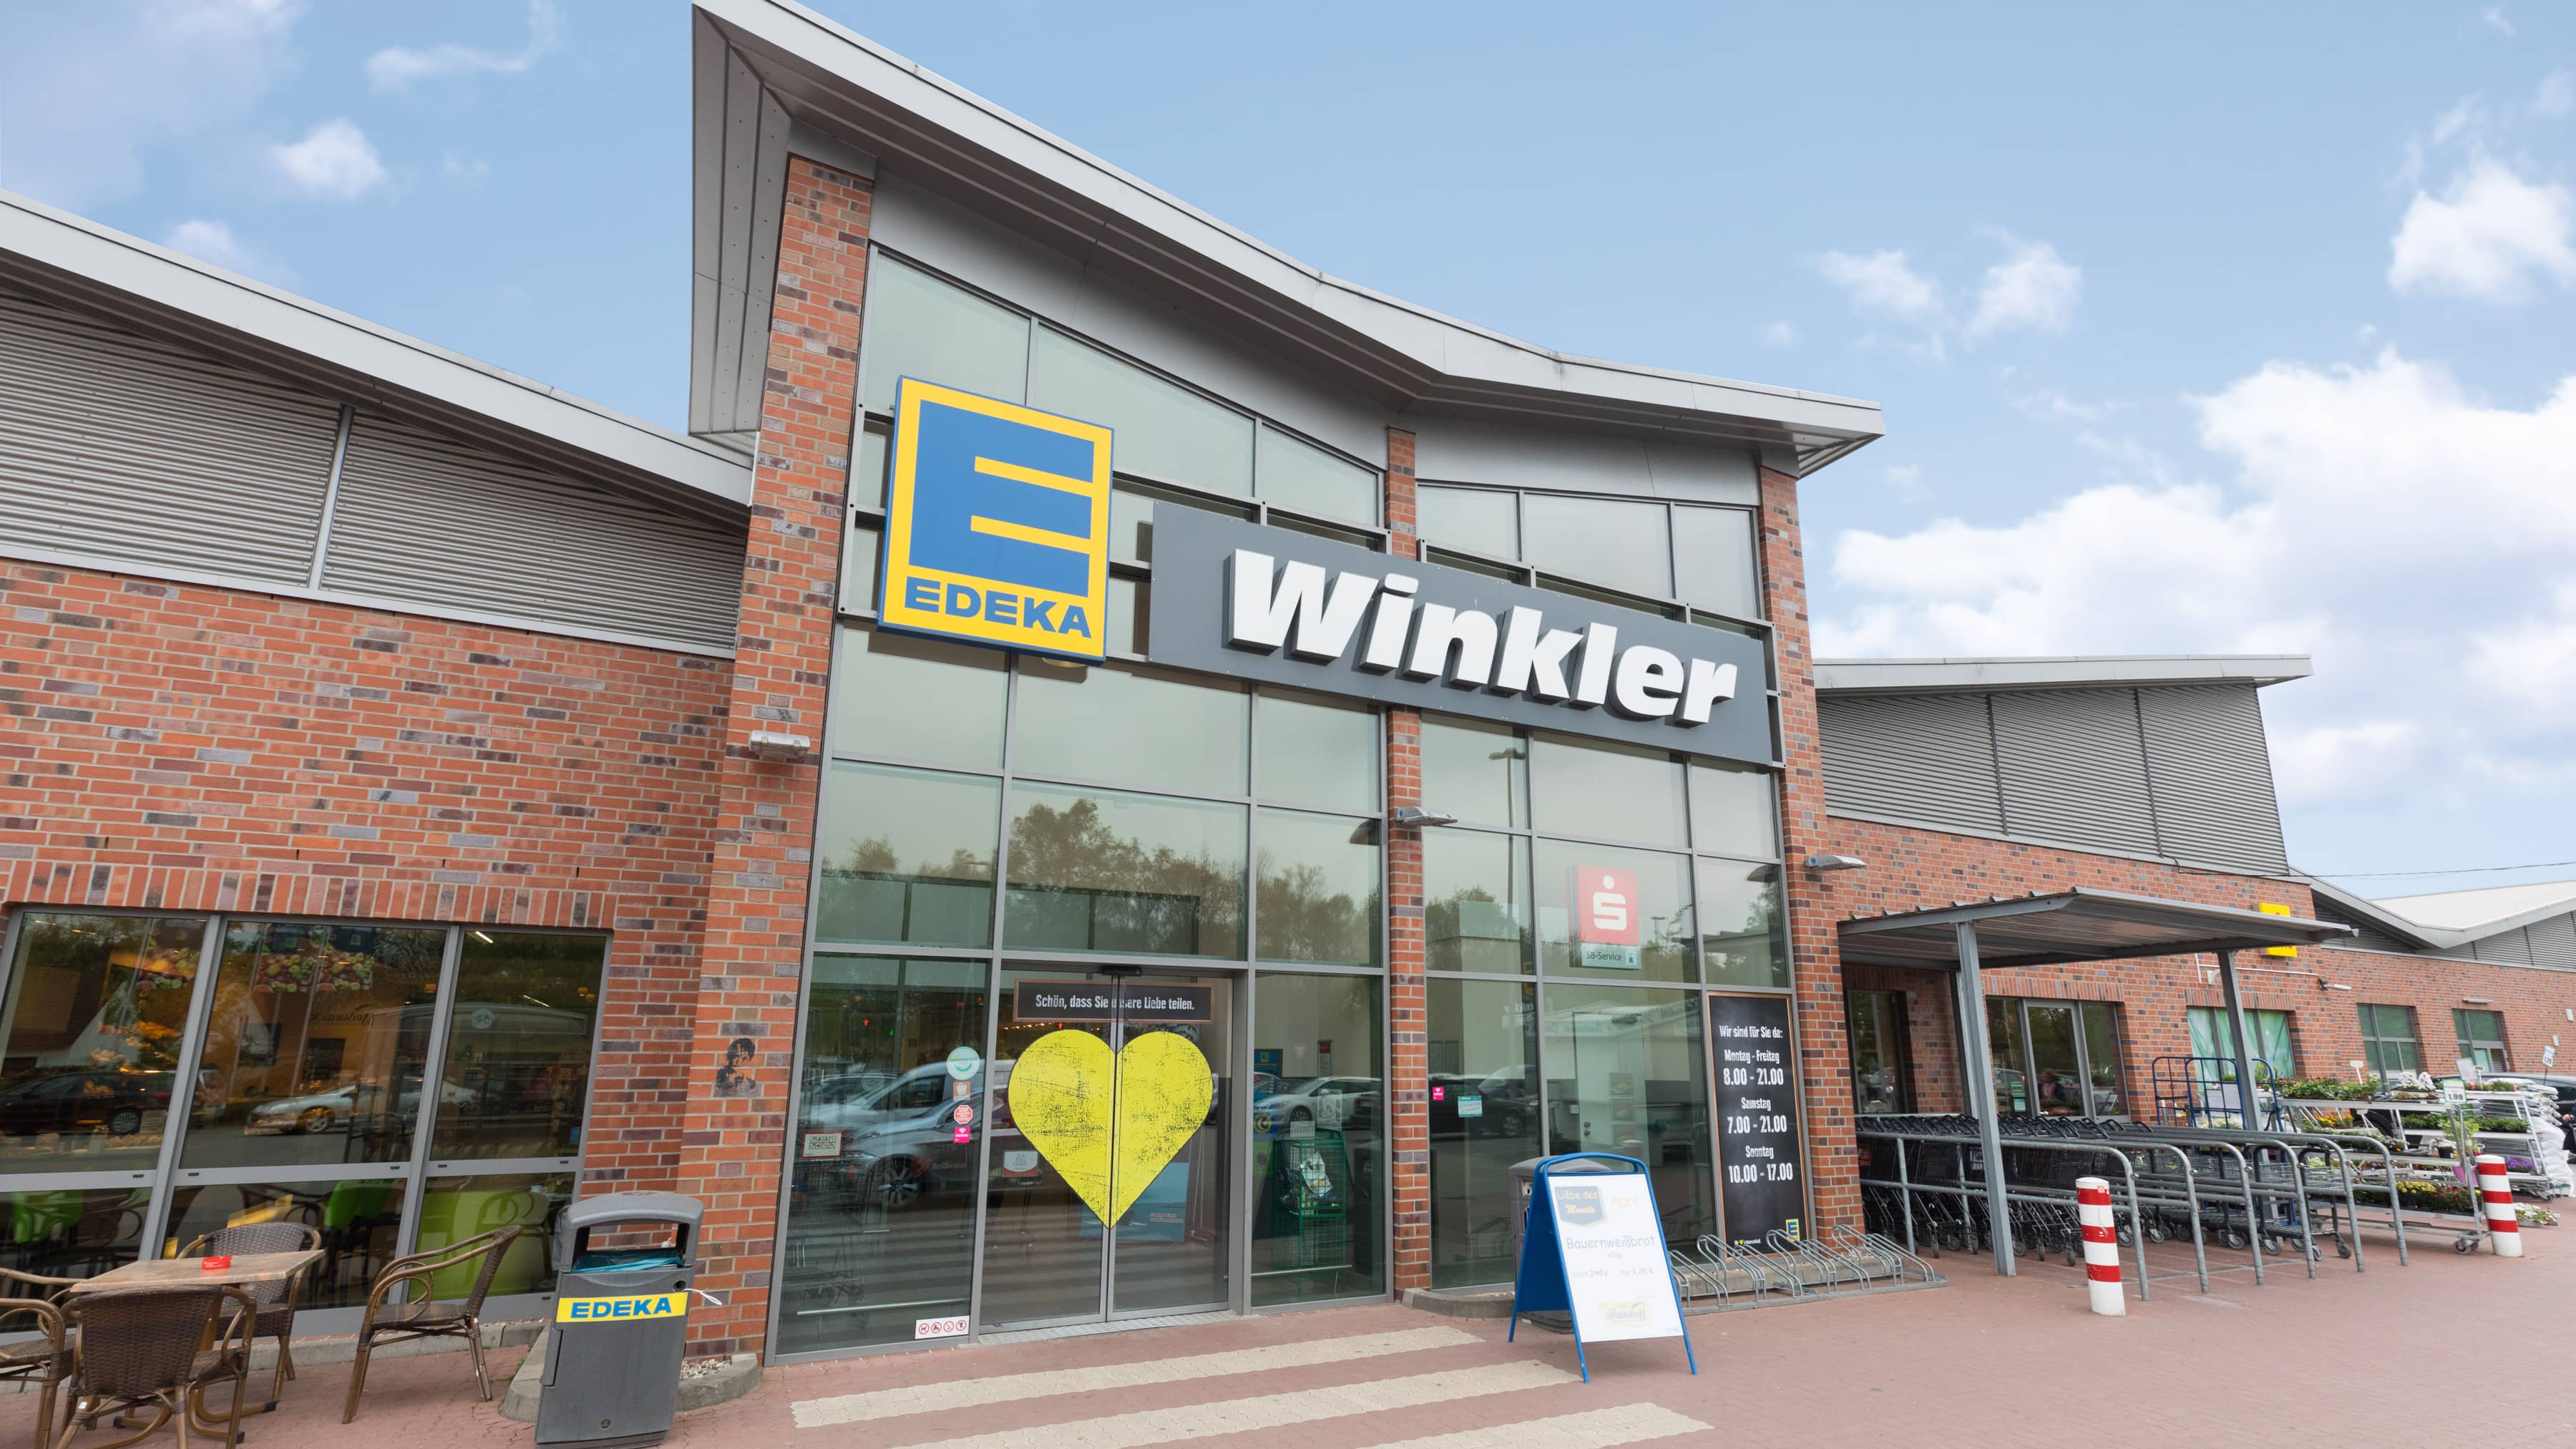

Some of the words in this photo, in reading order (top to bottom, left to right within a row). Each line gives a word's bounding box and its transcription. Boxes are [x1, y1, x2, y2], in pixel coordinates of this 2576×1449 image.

[904, 575, 1092, 639] EDEKA
[1227, 548, 1738, 726] Winkler
[1586, 950, 1622, 961] SB-Service
[1035, 994, 1067, 1009] Schön,
[1070, 995, 1092, 1008] dass
[1095, 995, 1108, 1008] Sie
[1144, 996, 1166, 1010] Liebe
[1169, 997, 1195, 1010] teilen.
[1719, 1025, 1732, 1037] Wir
[1733, 1025, 1748, 1038] sind
[1749, 1025, 1760, 1038] für
[1760, 1026, 1772, 1038] Sie
[1772, 1027, 1783, 1038] da:
[1724, 1049, 1751, 1064] Montag
[1756, 1050, 1780, 1064] Freitag
[1723, 1068, 1747, 1085] 8.00
[1756, 1068, 1784, 1085] 21.00
[1741, 1097, 1771, 1111] Samstag
[1727, 1116, 1750, 1133] 7.00
[1760, 1115, 1787, 1133] 21.00
[1745, 1145, 1774, 1159] Sonntag
[1728, 1164, 1757, 1184] 10.00
[1767, 1162, 1793, 1181] 17.00
[1556, 1189, 1581, 1200] Liebe
[1582, 1189, 1598, 1199] des
[1611, 1196, 1639, 1211] April
[1566, 1235, 1655, 1249] Bauernweißbrot
[570, 1297, 672, 1319] EDEKA
